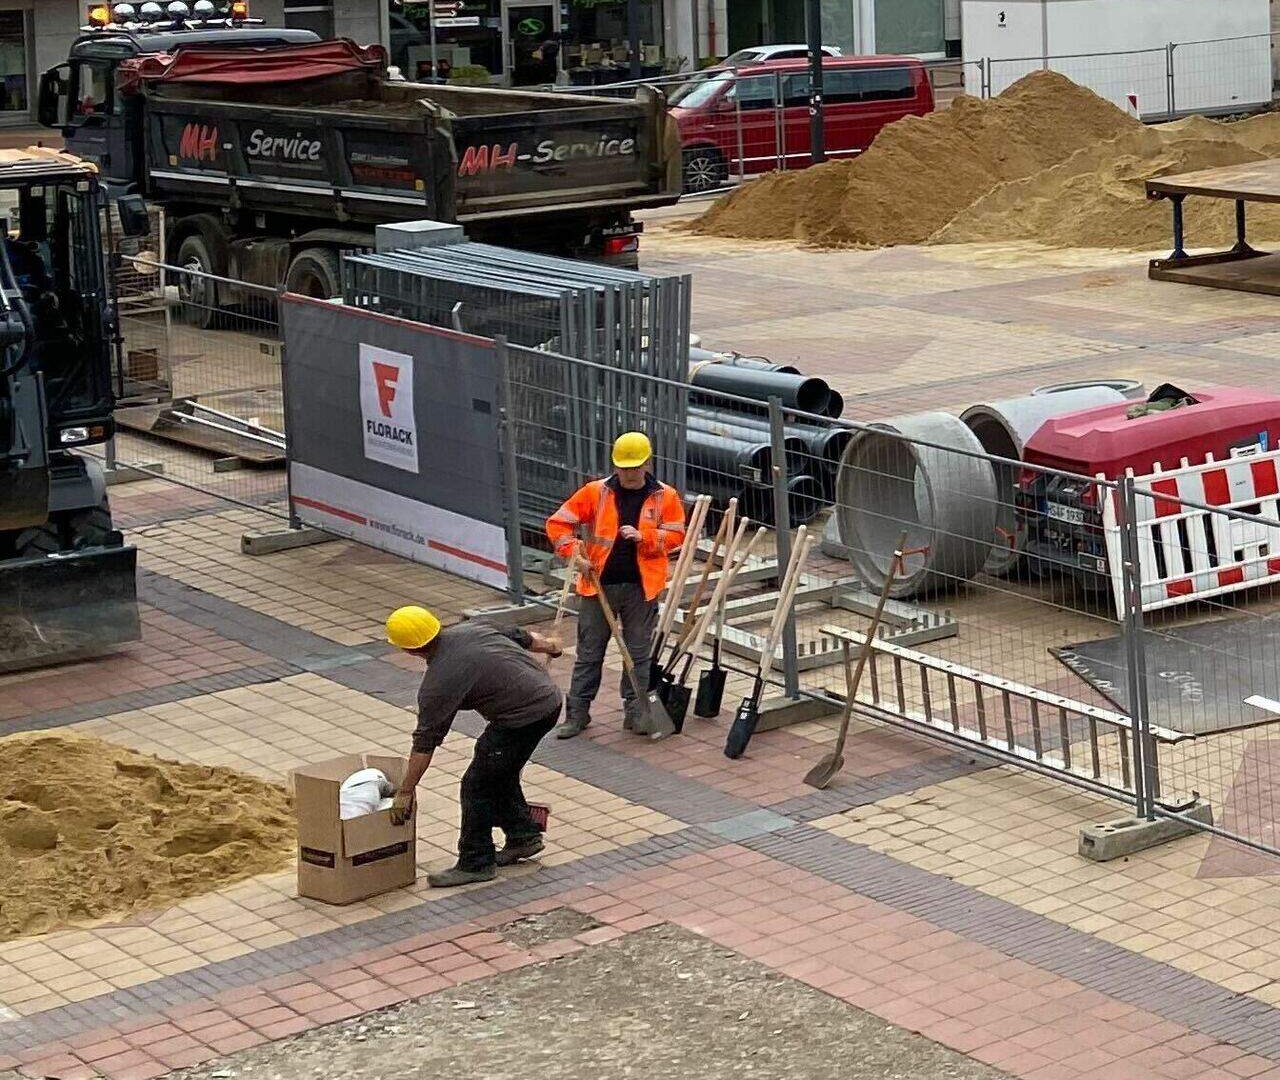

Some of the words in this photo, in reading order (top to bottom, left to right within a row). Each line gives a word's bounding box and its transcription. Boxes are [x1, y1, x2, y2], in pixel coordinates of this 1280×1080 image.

[180, 123, 218, 161] MH
[247, 128, 321, 160] Service
[366, 420, 413, 445] FLORACK
